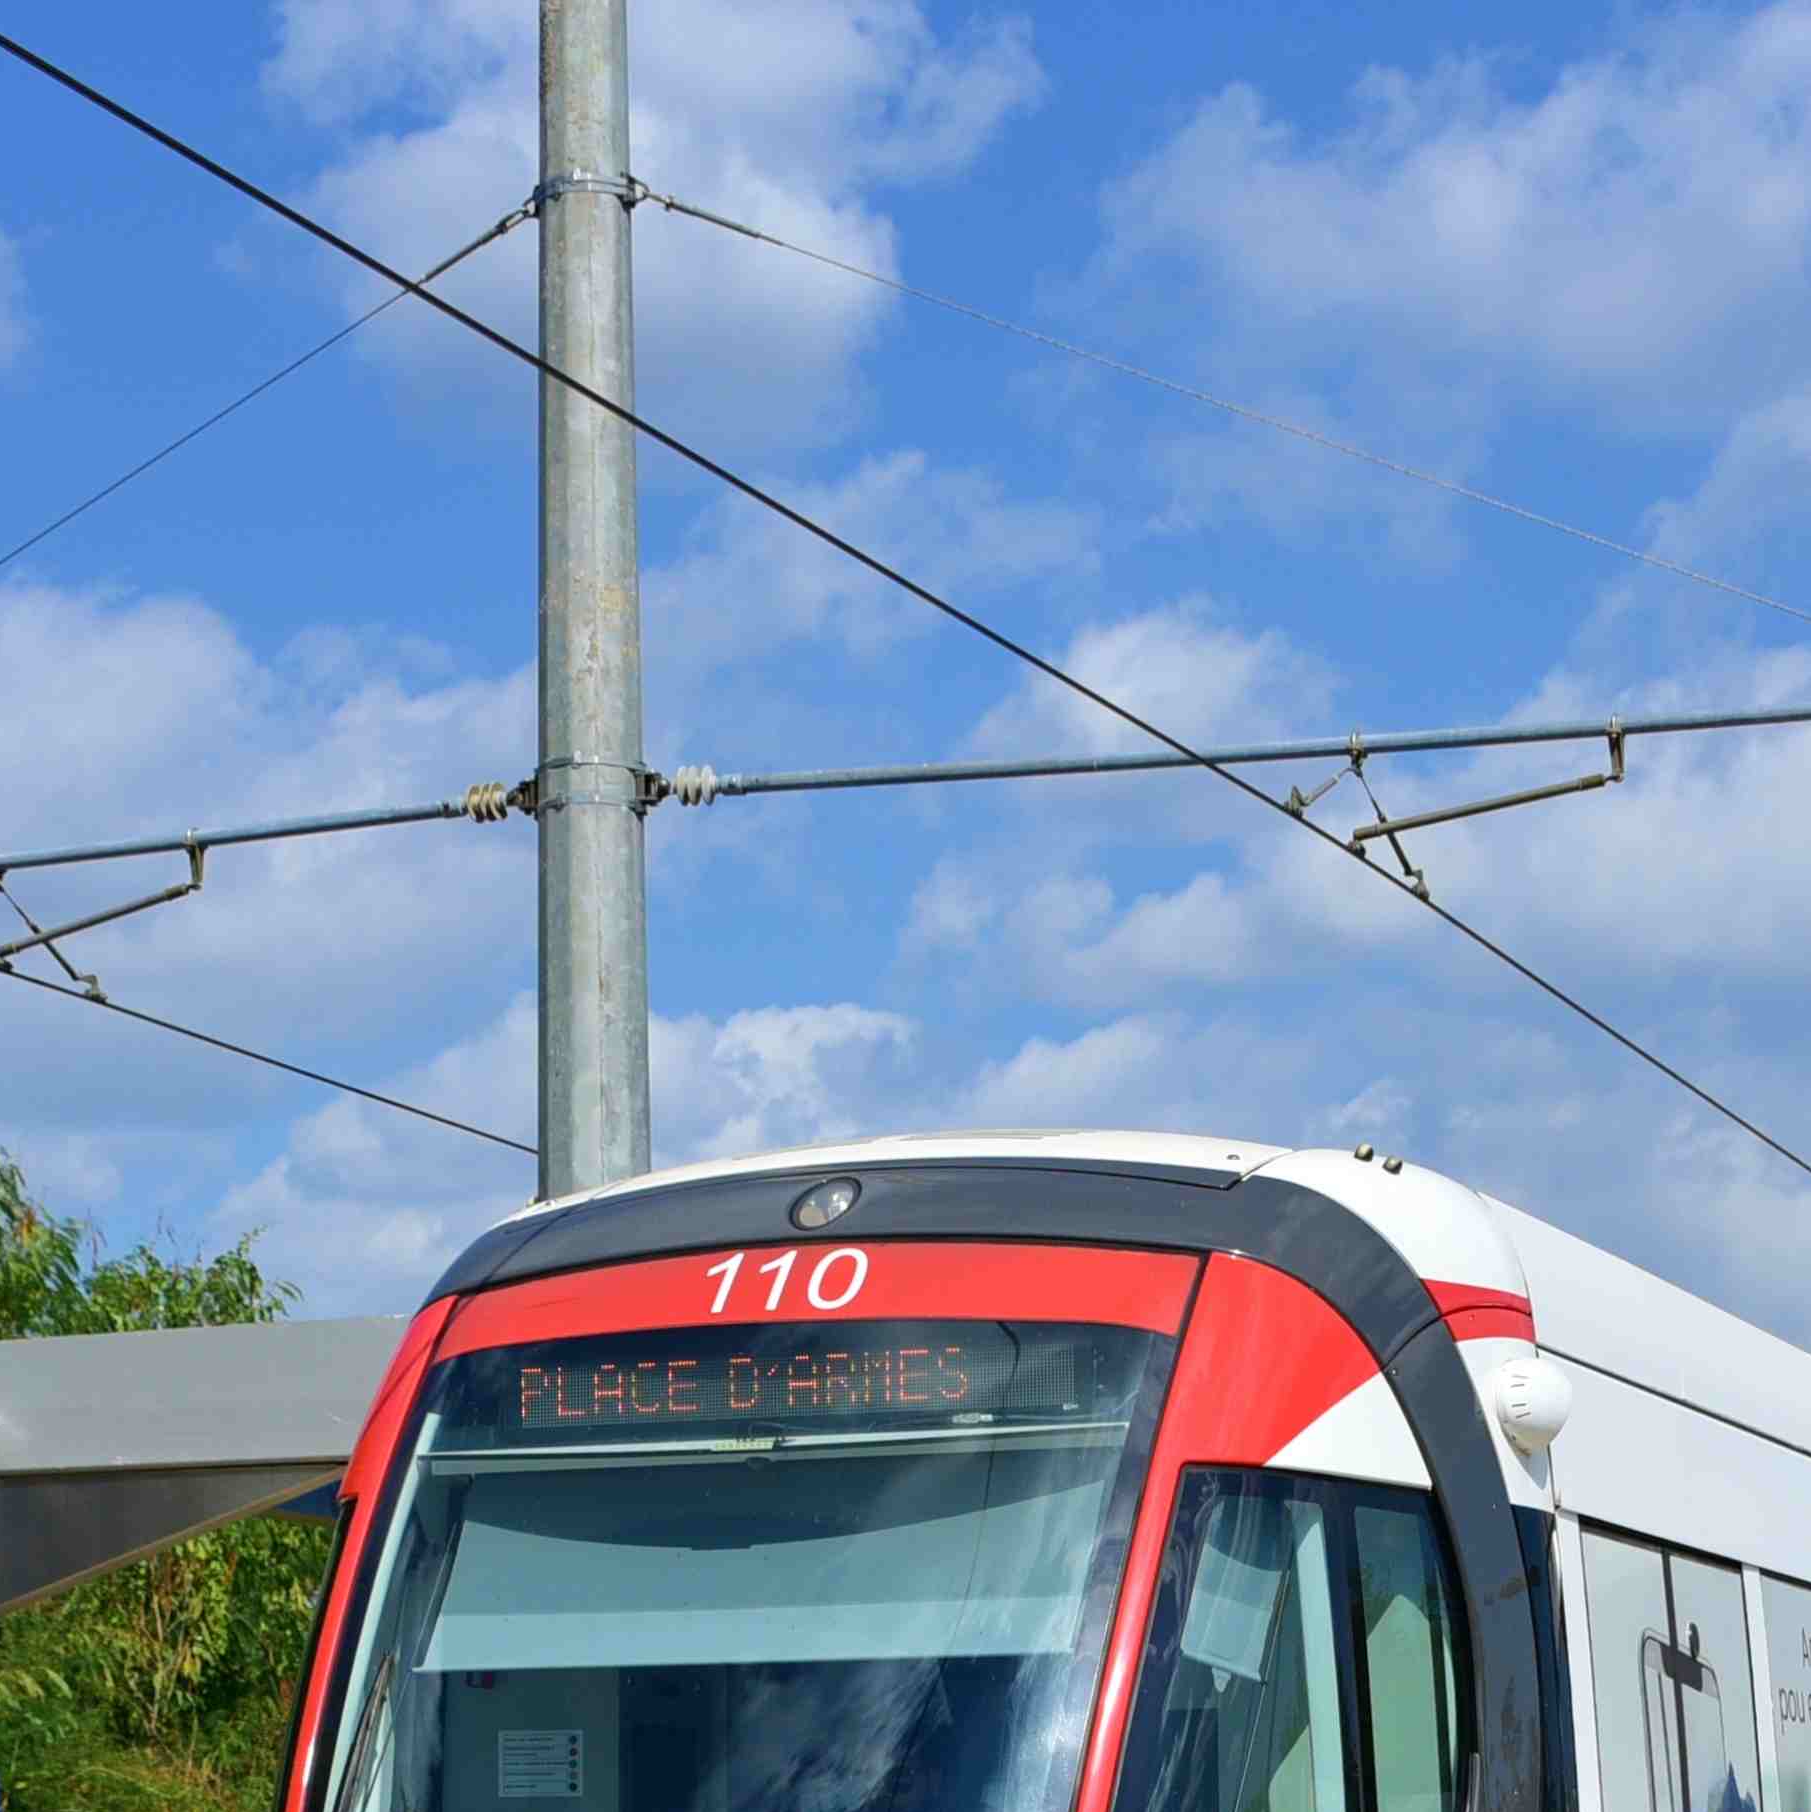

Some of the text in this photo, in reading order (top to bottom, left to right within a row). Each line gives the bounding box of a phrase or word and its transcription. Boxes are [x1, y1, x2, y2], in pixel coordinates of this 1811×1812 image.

[705, 1248, 870, 1314] 110
[520, 1347, 970, 1419] PLACE D'ARMES
[1778, 1688, 1805, 1734] pou
